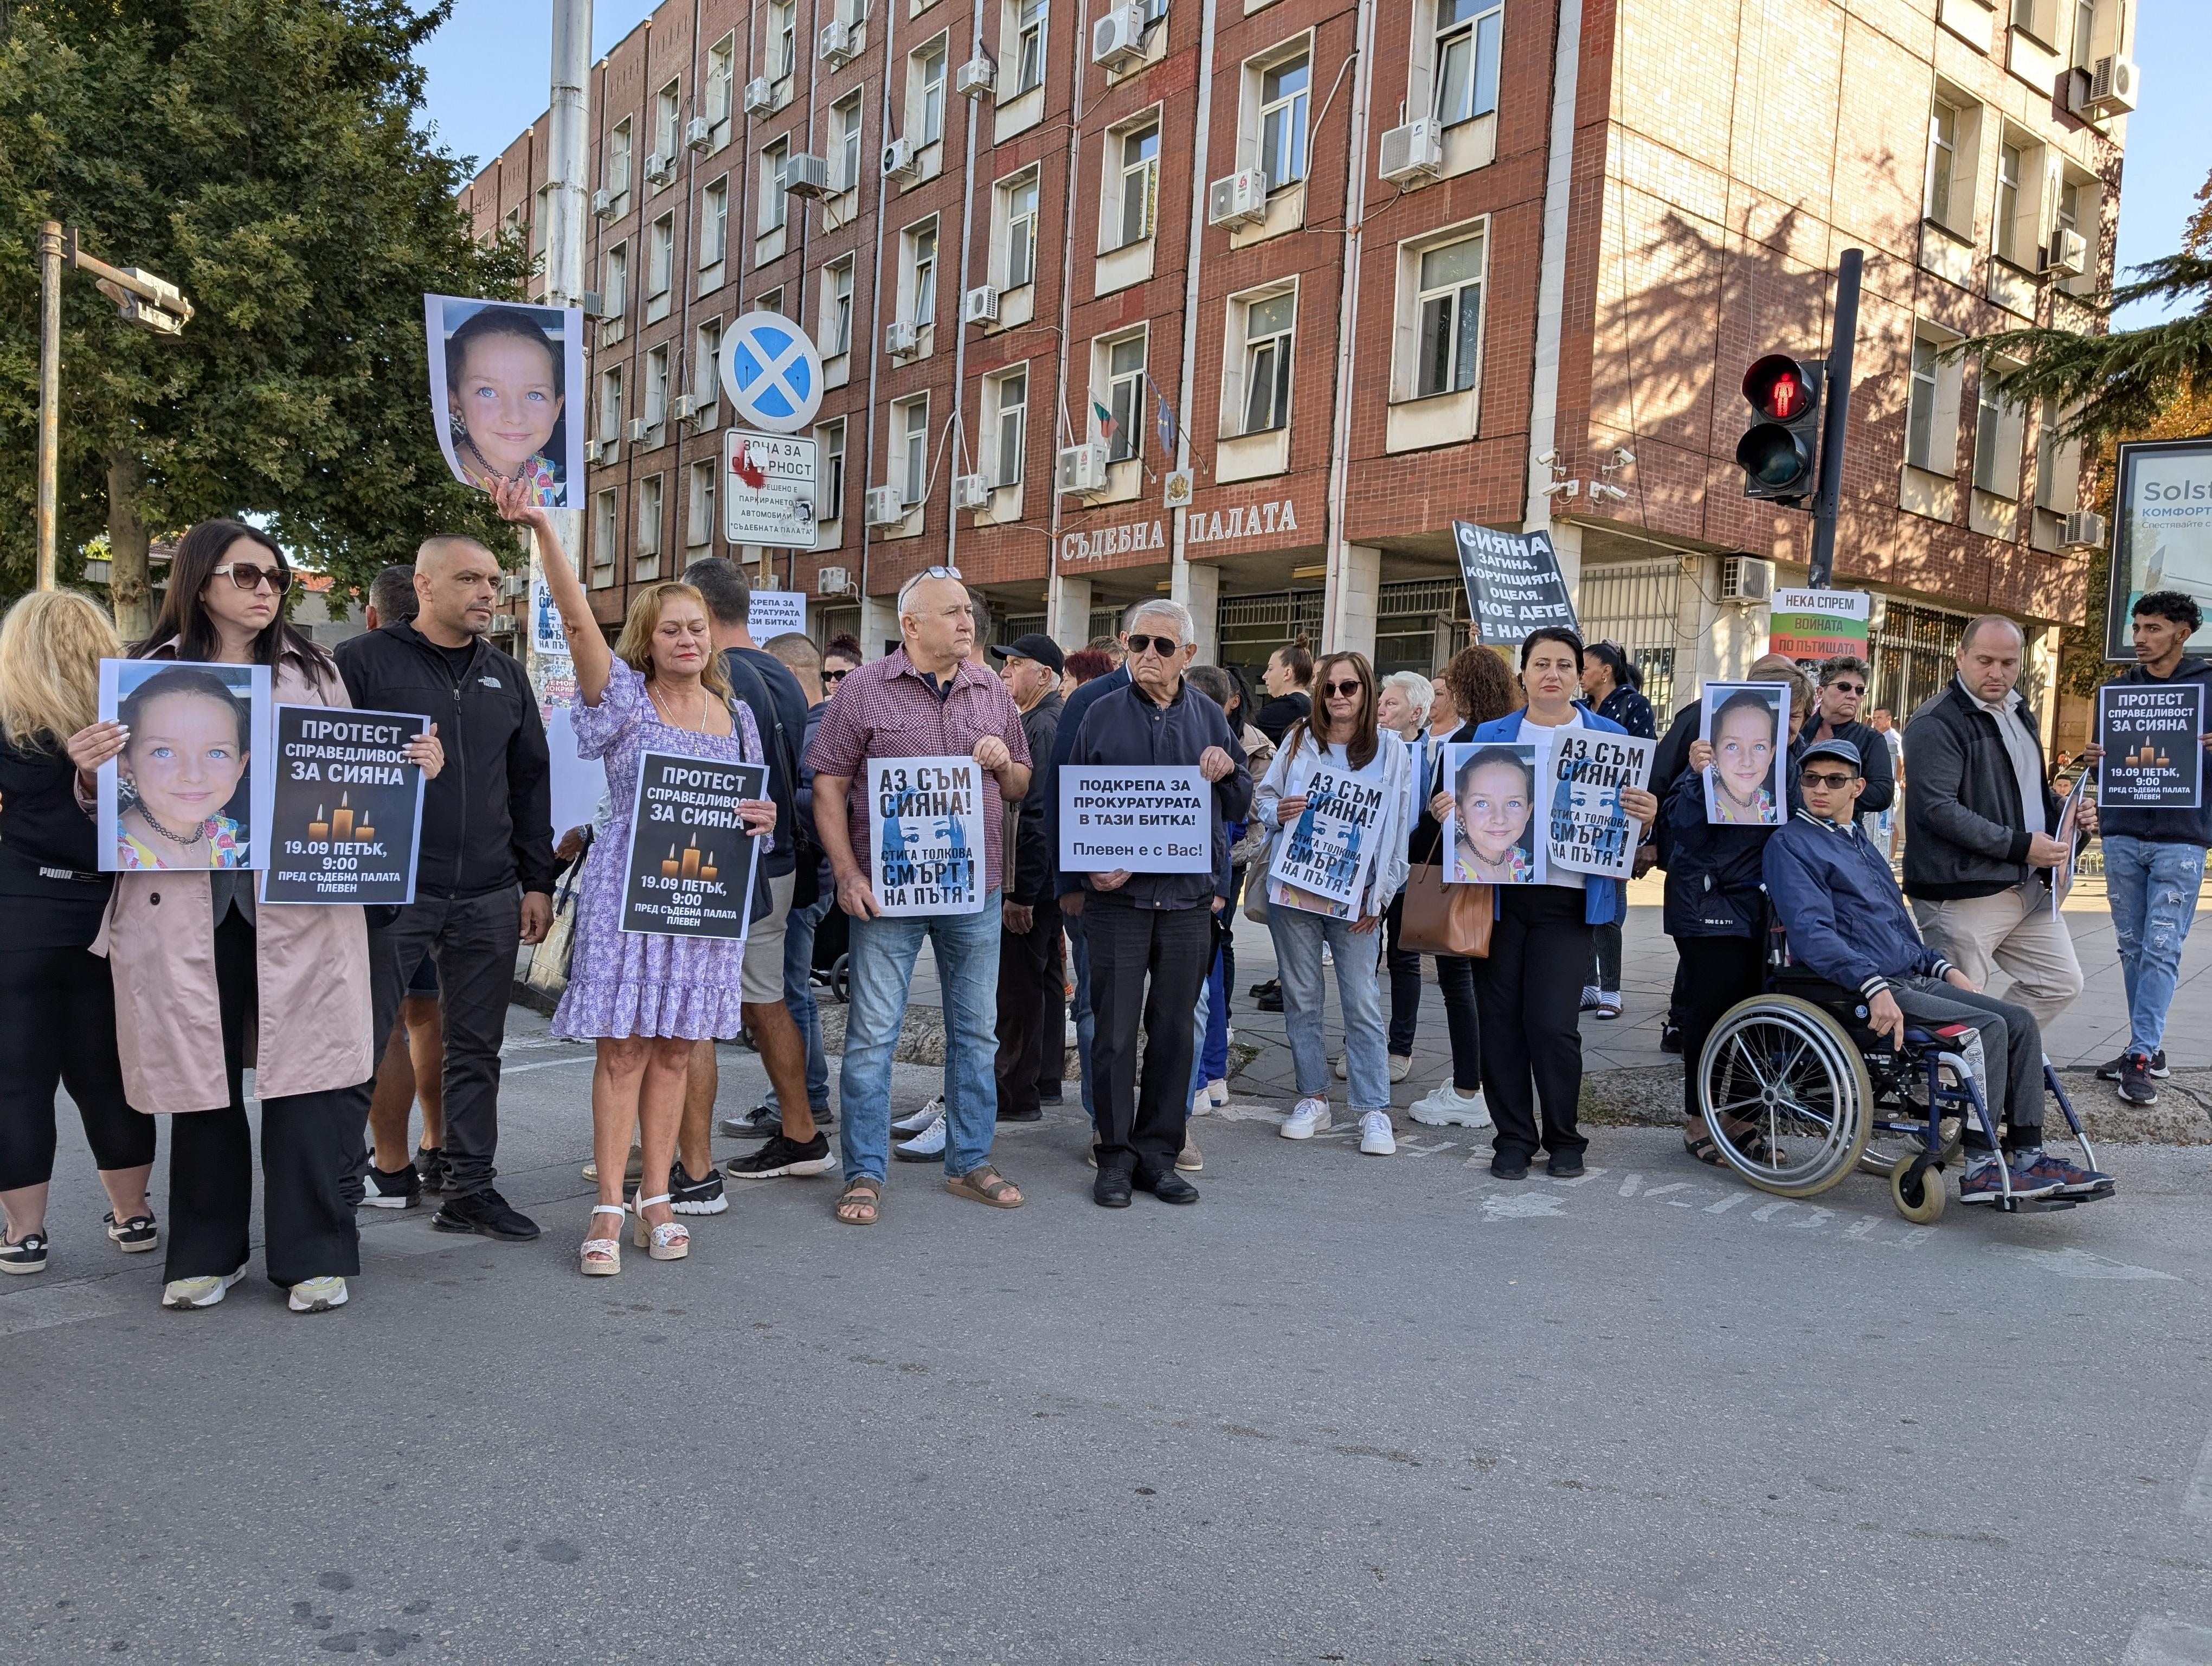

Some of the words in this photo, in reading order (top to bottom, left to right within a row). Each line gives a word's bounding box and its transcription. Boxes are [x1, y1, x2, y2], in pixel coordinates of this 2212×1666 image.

[784, 445, 801, 457] ЗА
[739, 495, 793, 507] ПАРКИРАНЕТО
[741, 510, 792, 520] АВТОМОБИЛИ
[1062, 521, 1165, 563] СЪДЕБНА
[1188, 500, 1297, 543] ПАЛАТА
[2142, 520, 2203, 529] Спестявайте
[1459, 528, 1551, 556] СИЯНА
[1478, 553, 1538, 572] ЗАГИНА,
[1466, 566, 1561, 587] КОРУПЦИЯТА
[1490, 587, 1544, 601] ОЦЕЛЯ.
[1786, 594, 1815, 607] НЕКА
[1817, 597, 1854, 610] СПРЕМ
[1478, 600, 1515, 618] КОЕ
[1519, 603, 1568, 620] ДЕТЕ
[1481, 623, 1494, 637] Е
[1795, 616, 1843, 632] ВОЙНАТА
[539, 640, 549, 649] НА
[552, 641, 568, 650] ПЪТ
[1779, 639, 1793, 651] ПО
[1797, 640, 1855, 655] ПЪТИЩАТА
[2118, 693, 2184, 706] ПРОТЕСТ
[2108, 708, 2194, 718] СПРАВЕДЛИВОСТ
[301, 720, 402, 744] ПРОТЕСТ
[2112, 720, 2131, 732] ЗА
[2136, 719, 2188, 731] СИЯНА
[1560, 738, 1587, 760] АЗ
[1596, 742, 1645, 769] СЪМ
[291, 761, 321, 781] ЗА
[328, 764, 404, 785] СИЯНА
[661, 766, 747, 792] ПРОТЕСТ
[879, 768, 907, 792] АЗ
[917, 767, 972, 791] СЪМ
[1556, 759, 1641, 789] СИЯНА!
[2111, 768, 2139, 777] 19.09
[2143, 768, 2179, 778] ПЕТЪК,
[1080, 780, 1166, 793] ПОДКРЕПА
[1171, 780, 1191, 791] ЗА
[1309, 772, 1333, 793] АЗ
[1338, 780, 1382, 810] СЪМ
[879, 792, 972, 818] СИЯНА!
[1073, 797, 1201, 808] ПРОКУРАТУРАТА
[1306, 790, 1377, 829] СИЯНА!
[650, 804, 674, 822] ЗА
[681, 807, 744, 830] СИЯНА
[1079, 814, 1090, 825] В
[1095, 815, 1134, 825] ТАЗИ
[1139, 815, 1195, 825] БИТКА!
[1551, 808, 1580, 823] СТИГА
[1584, 813, 1629, 829] ТОЛКОВА
[285, 841, 329, 855] 19.09
[333, 842, 387, 858] ПЕТЪК,
[881, 849, 917, 862] СТИГА
[922, 847, 973, 860] ТОЛКОВА
[1073, 842, 1134, 856] Плевен
[1139, 846, 1148, 856] е
[1153, 846, 1162, 856] с
[1168, 844, 1203, 856] Вас!
[1291, 832, 1320, 849] СТИГА
[1323, 841, 1361, 862] ТОЛКОВА
[1552, 843, 1566, 860] НА
[1571, 845, 1613, 864] ПЪТЯ
[322, 857, 358, 870] 9:00
[39, 867, 73, 879] PUMA
[278, 871, 306, 882] ПРЕД
[309, 872, 358, 883] СЪДЕБНА
[361, 873, 400, 882] ПАЛАТА
[1281, 861, 1299, 877] НА
[1303, 869, 1343, 893] ПЪТЯ
[317, 883, 357, 893] ПЛЕВЕН
[641, 875, 678, 889] 19.09
[682, 879, 727, 896] ПЕТЪК,
[672, 893, 702, 906] 9:00
[884, 888, 906, 907] НА
[915, 886, 962, 905] ПЪТЯ
[634, 904, 658, 914] ПРЕД
[660, 906, 702, 917] СЪДЕБНА
[704, 909, 737, 919] ПАЛАТА
[666, 917, 700, 926] ПЛЕВЕН
[1963, 1031, 1983, 1066] BACK
